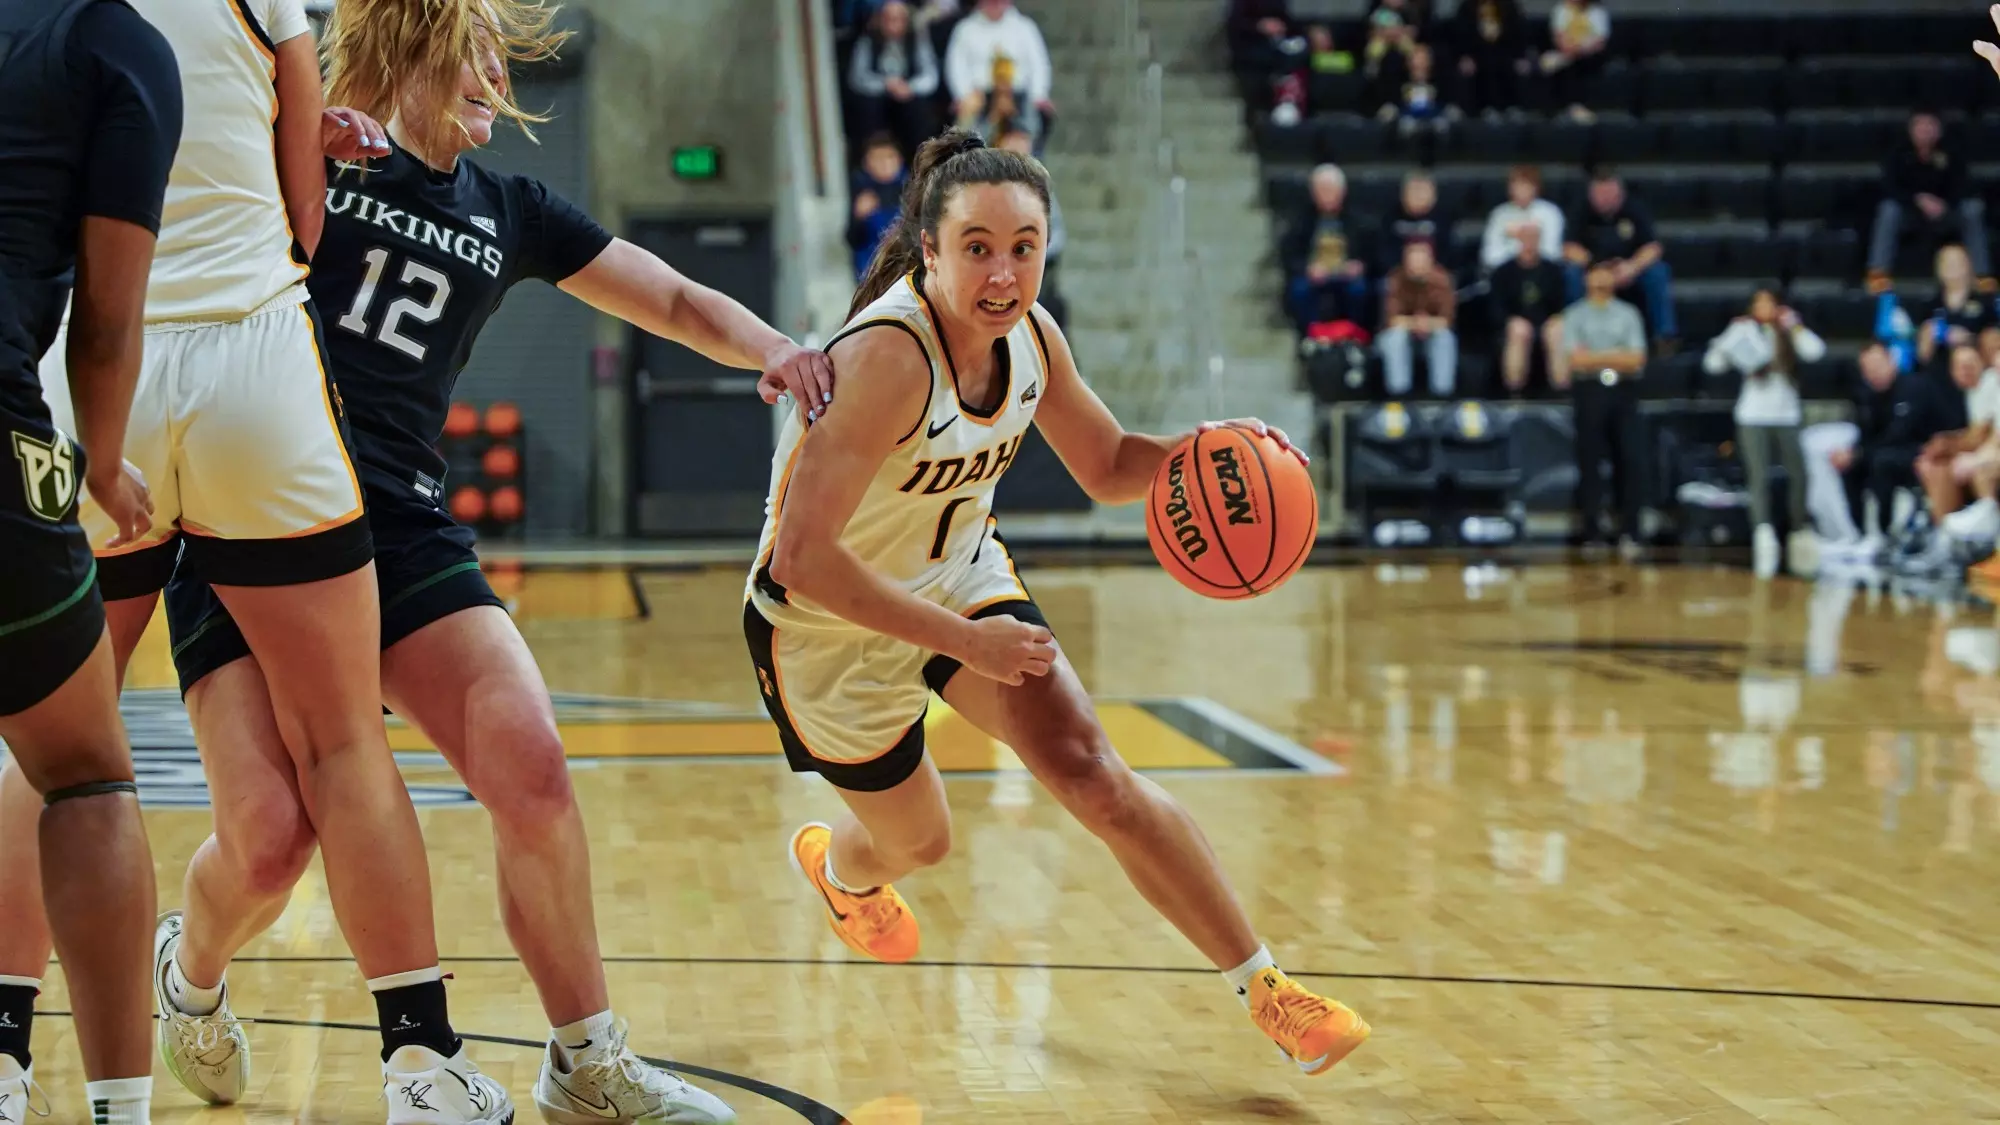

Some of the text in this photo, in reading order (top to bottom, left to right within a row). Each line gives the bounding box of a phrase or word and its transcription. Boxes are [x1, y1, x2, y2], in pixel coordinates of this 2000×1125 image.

[324, 188, 503, 278] VIKINGS
[337, 247, 452, 362] 12
[1165, 450, 1209, 562] Wilson
[1209, 447, 1254, 525] NCAA
